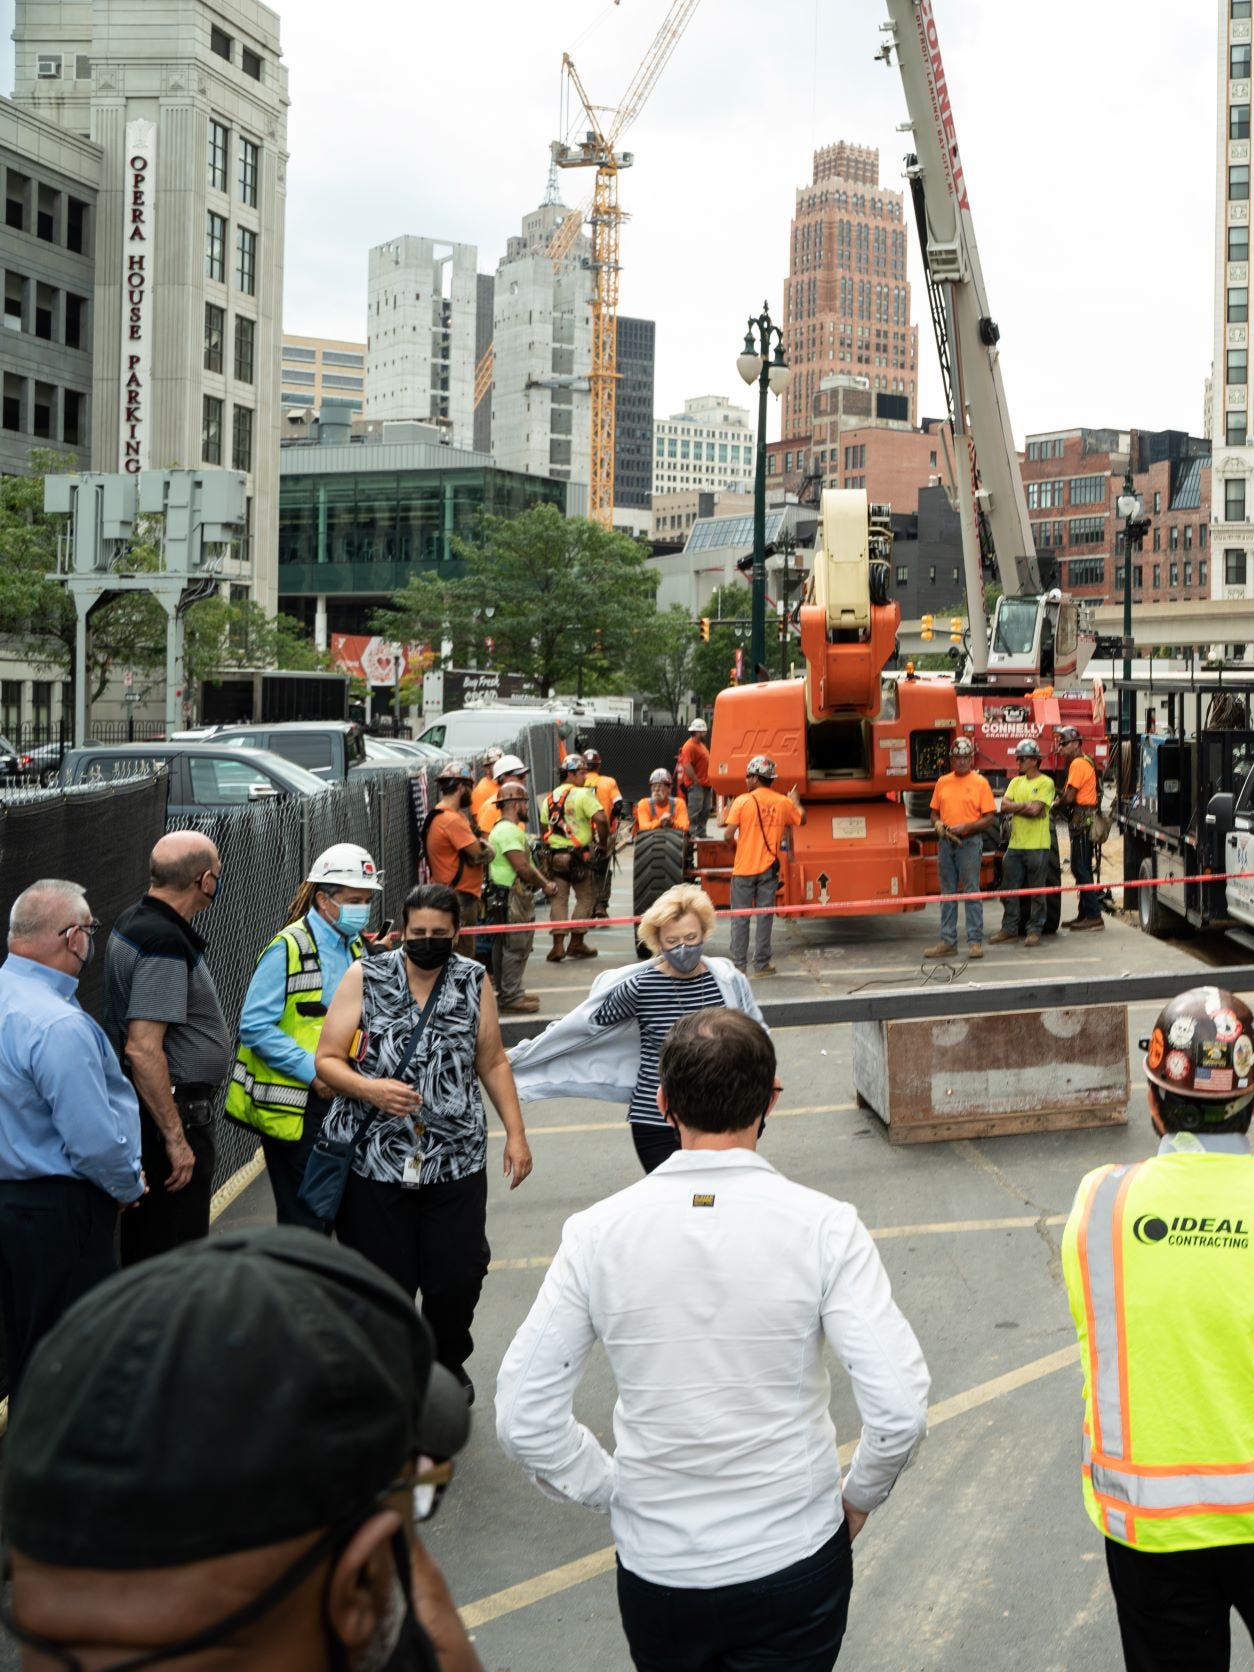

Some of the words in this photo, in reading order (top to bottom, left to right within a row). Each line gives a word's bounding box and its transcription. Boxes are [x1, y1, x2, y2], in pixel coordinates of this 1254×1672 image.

[916, 15, 929, 63] DETROIT
[927, 72, 939, 121] LANSING
[937, 129, 946, 150] BAY
[130, 156, 147, 241] OPERA
[127, 255, 145, 340] HOUSE
[124, 355, 142, 474] PARKING
[463, 676, 478, 691] Buy
[730, 728, 801, 758] JLG
[981, 722, 1045, 734] CONNELLY
[1171, 1216, 1249, 1235] IDEAL
[1168, 1234, 1249, 1249] CONTRACTING
